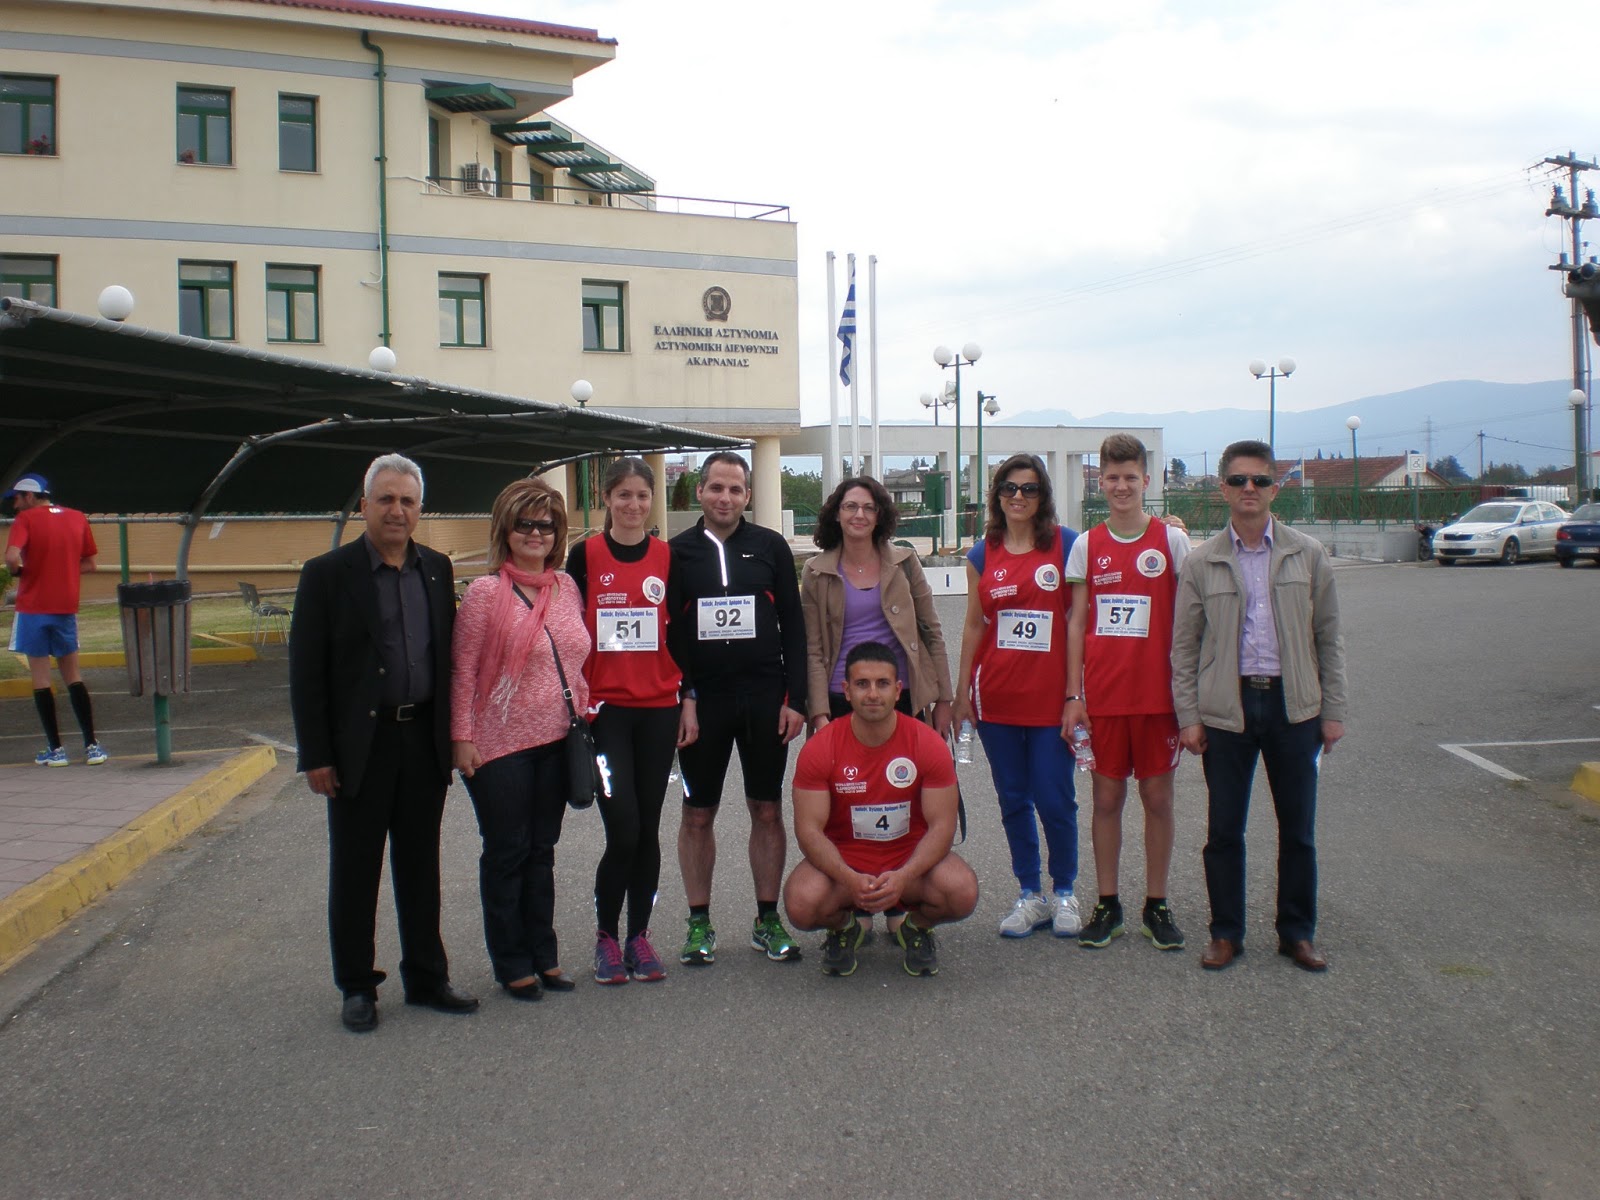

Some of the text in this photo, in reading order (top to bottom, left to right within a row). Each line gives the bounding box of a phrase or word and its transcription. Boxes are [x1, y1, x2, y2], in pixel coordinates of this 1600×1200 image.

[654, 325, 779, 340] ΕΛΛΗΝΙΚΗ ΑΣΤΥΝΟΜΙΑ
[655, 341, 778, 354] ΑΣΤΥΝΟΜΙΚΗ ΔΙΕΥΘΥΝΣΗ
[686, 356, 749, 367] ΑΚΑΡΝΑΝΙΑΣ
[715, 608, 741, 628] 92
[1109, 606, 1136, 625] 57
[616, 620, 641, 640] 51
[1012, 620, 1037, 640] 49
[875, 814, 890, 831] 4
